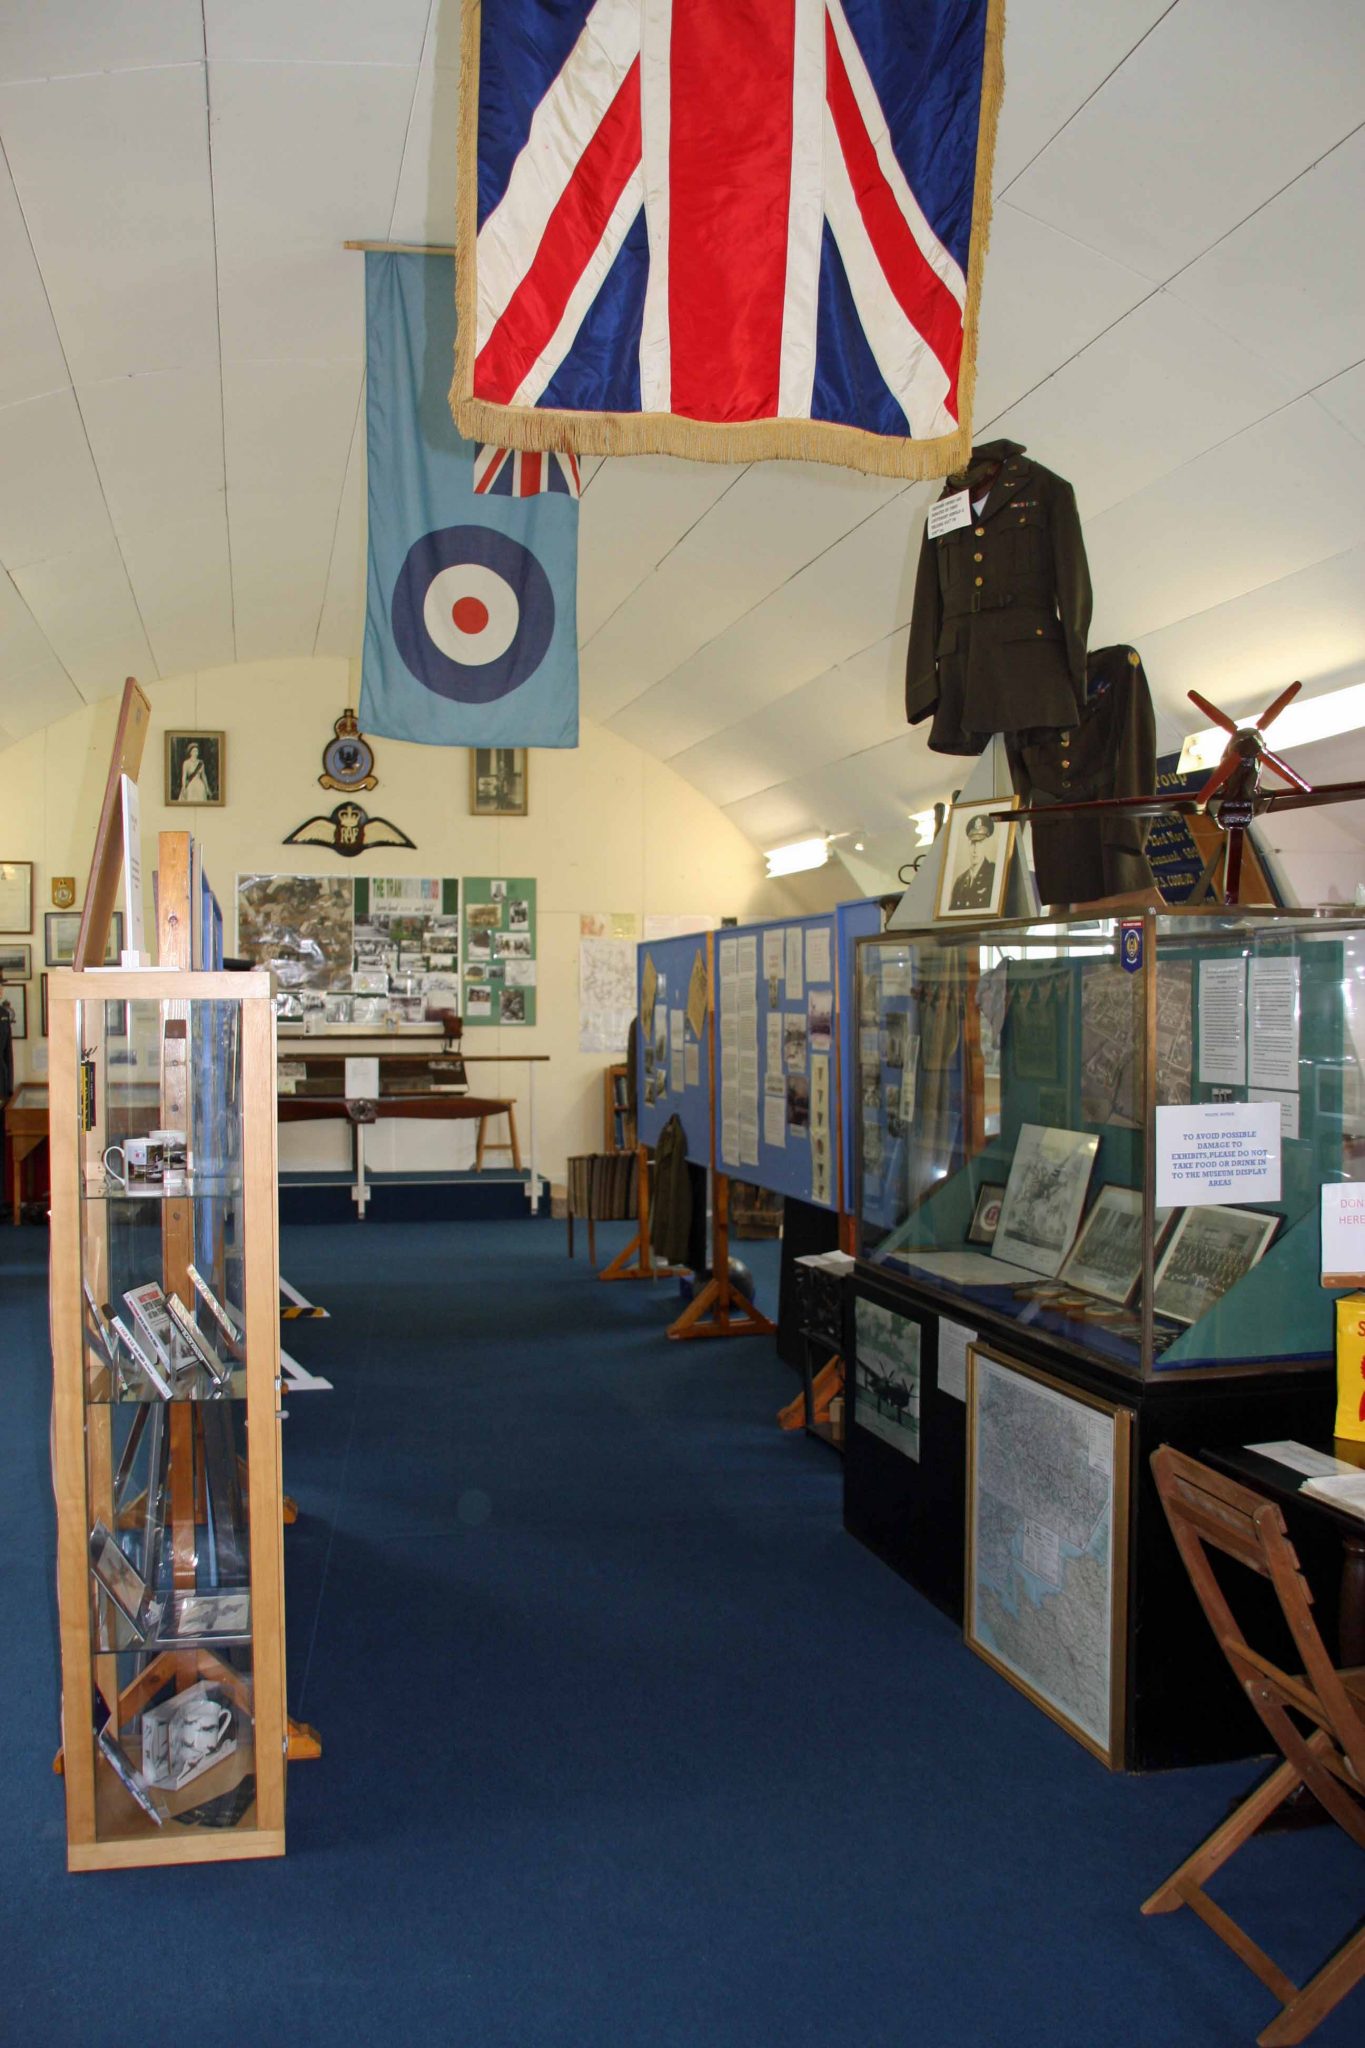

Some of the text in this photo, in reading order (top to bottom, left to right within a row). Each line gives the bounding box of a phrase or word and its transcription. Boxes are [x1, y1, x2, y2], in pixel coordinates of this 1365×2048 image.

[1156, 773, 1188, 788] roup
[340, 827, 359, 843] RAF
[1195, 1132, 1220, 1140] AVOID
[1221, 1131, 1257, 1139] POSSIBLE
[1197, 1141, 1230, 1149] DAMAGE
[1251, 1149, 1268, 1157] NOT
[1195, 1160, 1217, 1168] FOOD
[1231, 1159, 1256, 1167] DRINK
[1185, 1171, 1200, 1179] THE
[1201, 1169, 1235, 1178] MUSEUM
[1235, 1168, 1267, 1176] DISPLAY
[1208, 1179, 1232, 1187] AREAS
[1340, 1199, 1365, 1209] DON
[1339, 1215, 1365, 1225] HERE
